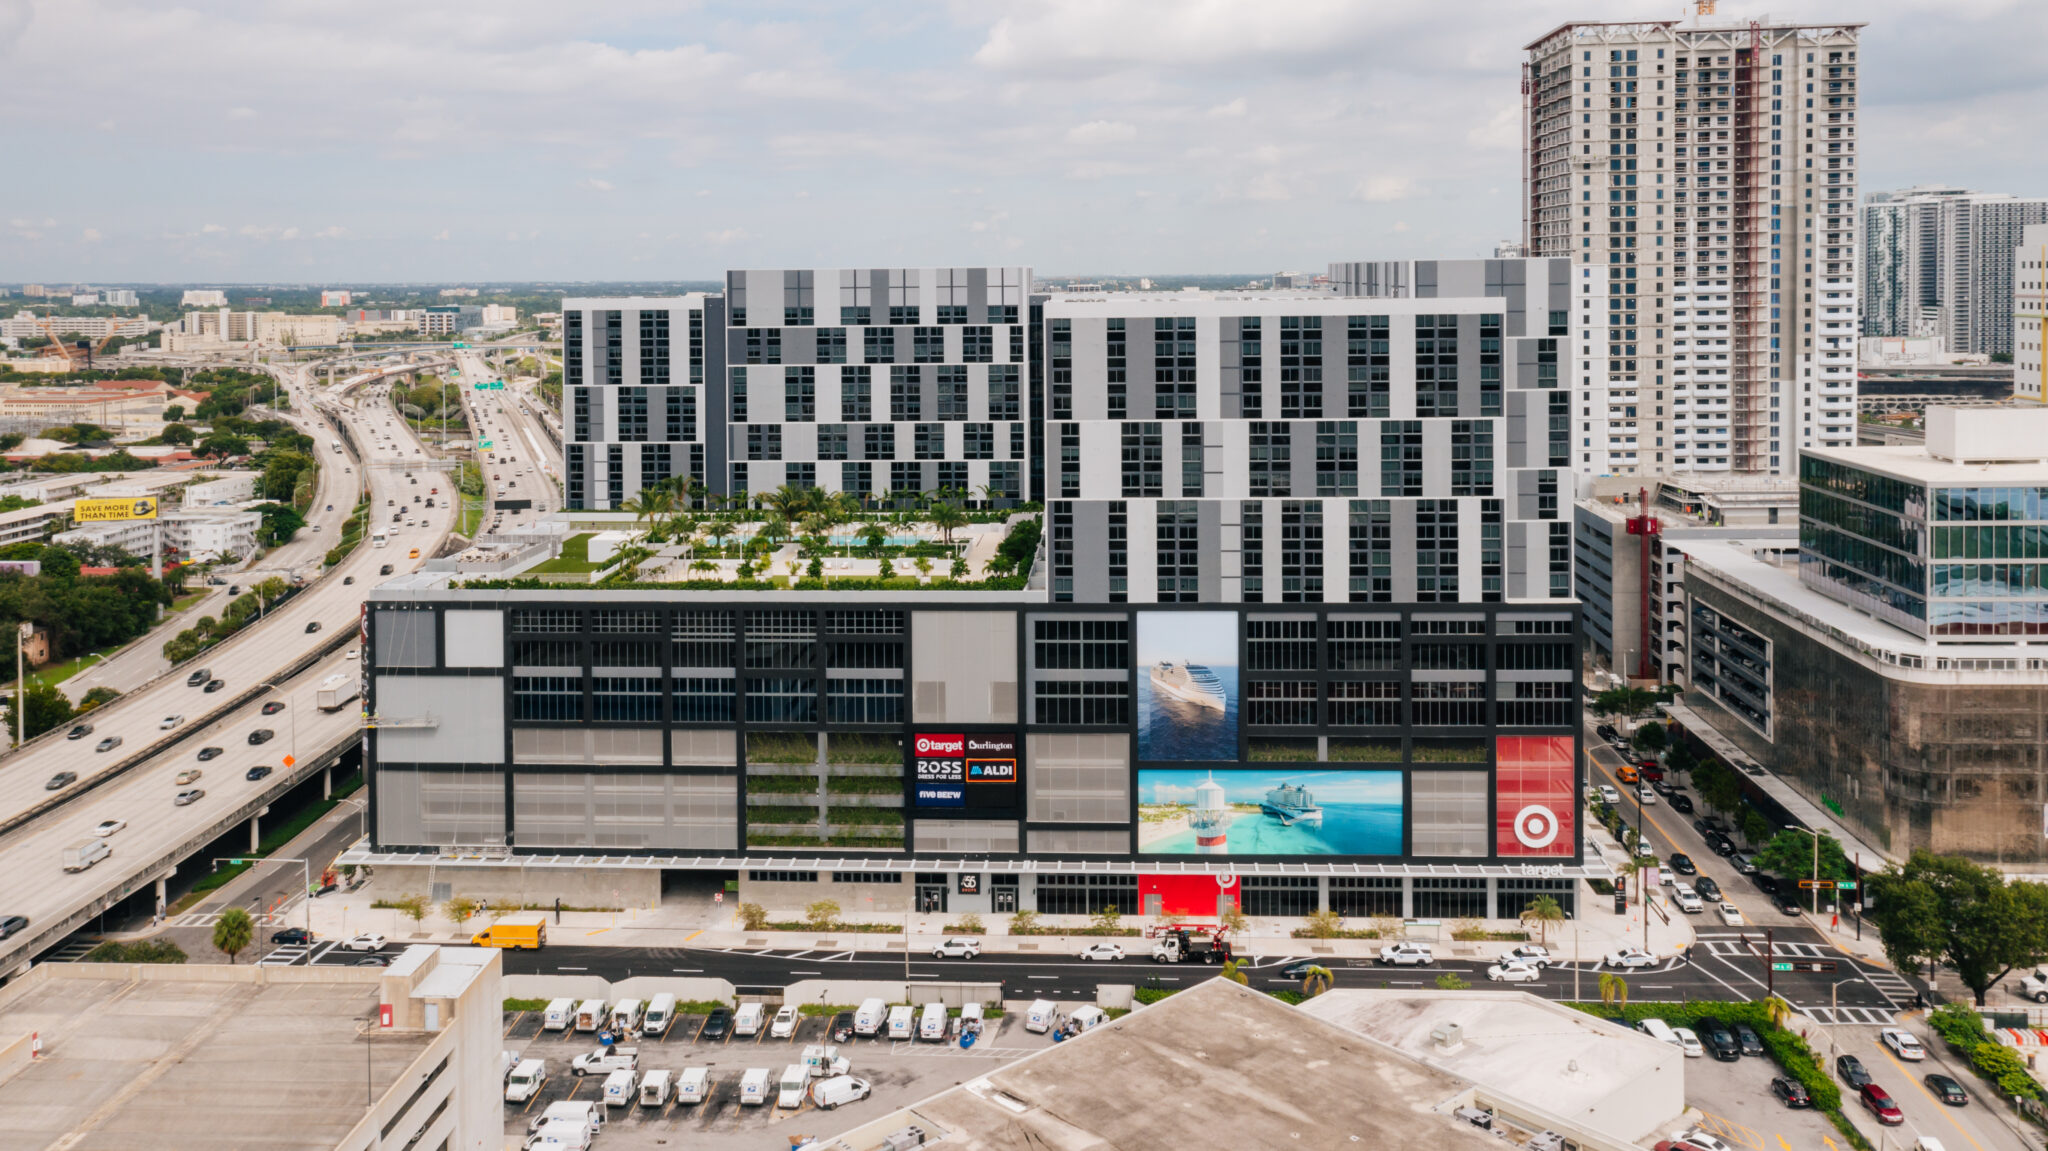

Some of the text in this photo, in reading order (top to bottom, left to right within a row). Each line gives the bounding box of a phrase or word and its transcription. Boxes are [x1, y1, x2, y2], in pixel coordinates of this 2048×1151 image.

[931, 740, 962, 752] target
[968, 740, 1013, 751] Burlington
[918, 761, 962, 774] ROSS
[983, 765, 1013, 776] ALDI
[1521, 863, 1564, 878] target
